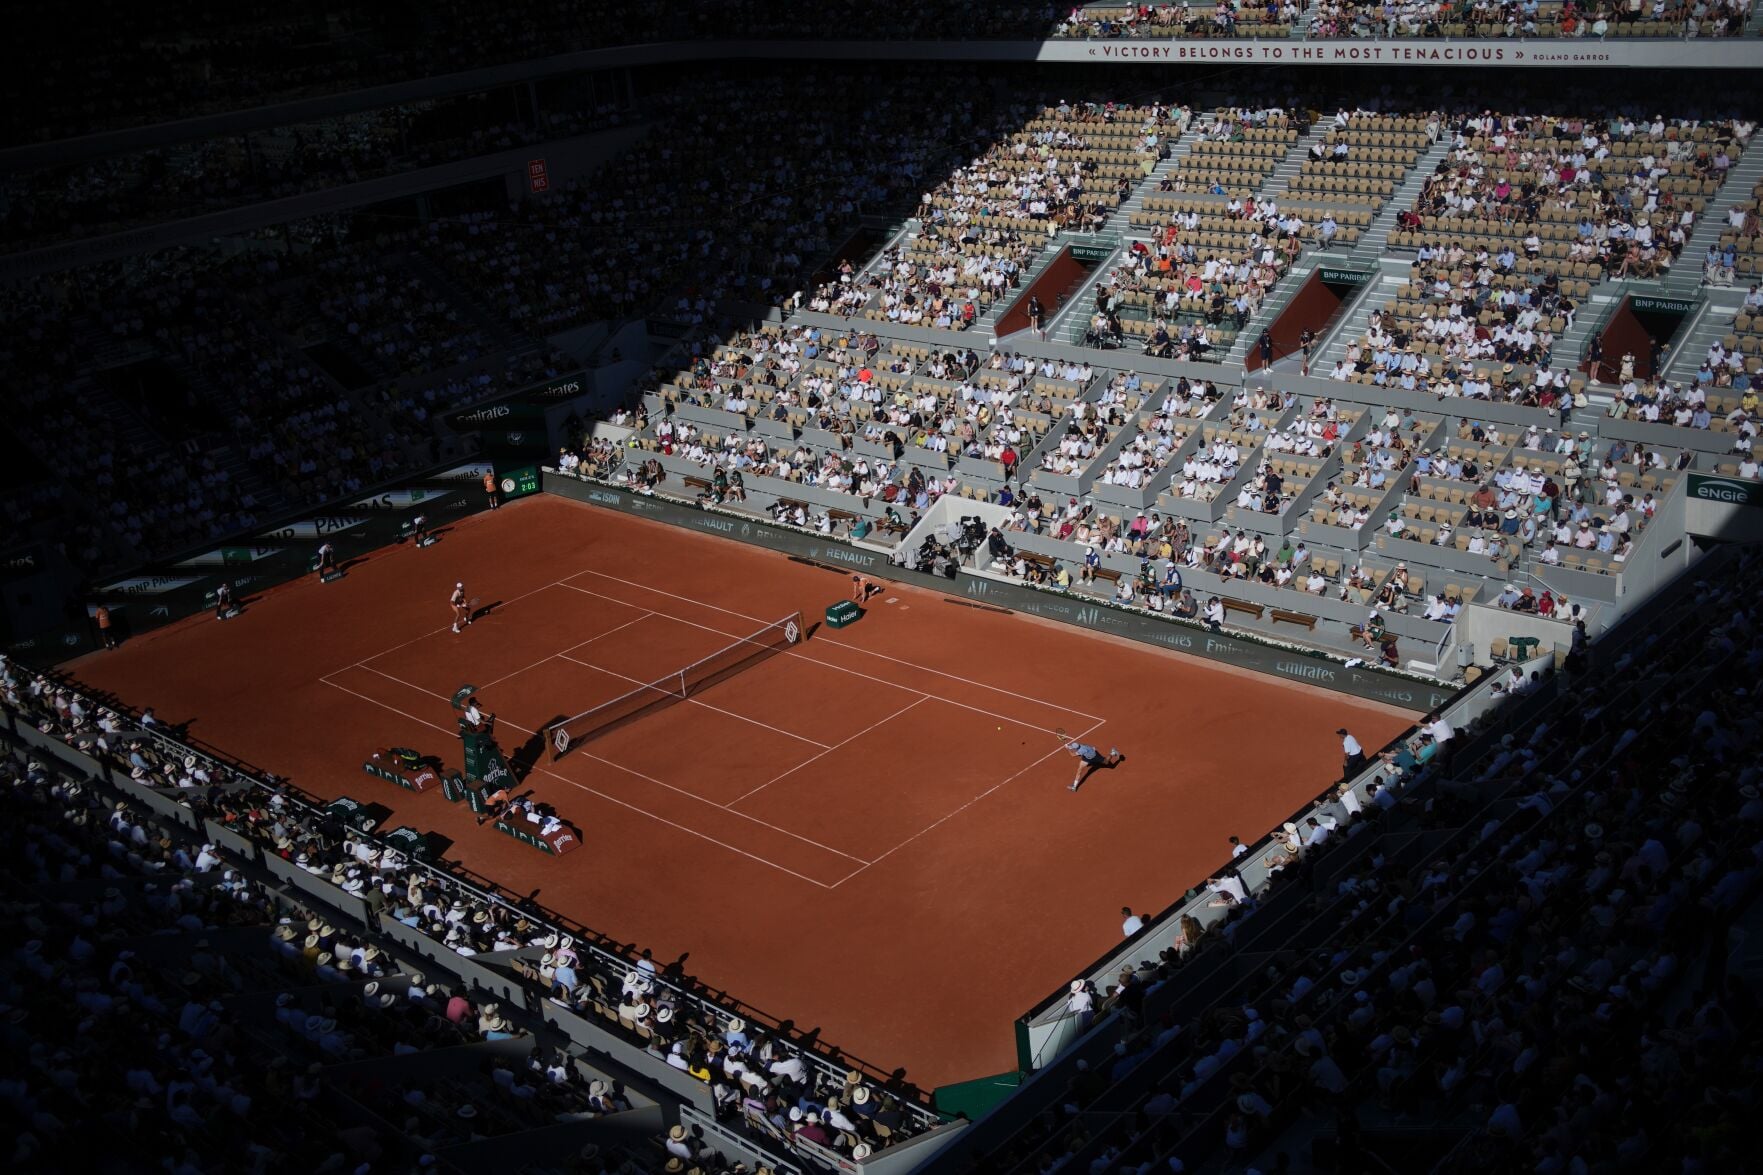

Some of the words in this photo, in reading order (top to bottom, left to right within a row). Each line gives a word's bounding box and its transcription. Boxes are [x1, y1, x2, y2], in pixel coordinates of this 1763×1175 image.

[1103, 46, 1171, 58] VICTORY
[1179, 47, 1253, 58] BELONGS
[1262, 47, 1282, 58] TO
[1291, 48, 1324, 58] THE
[1334, 48, 1382, 59] MOST
[1392, 48, 1504, 60] TENACIOUS
[1323, 271, 1339, 279] BNP
[1635, 299, 1654, 308] BNP
[522, 482, 536, 492] 2:03
[602, 491, 622, 505] ISDIN
[826, 548, 876, 567] RENAULT
[840, 610, 857, 623] Haier
